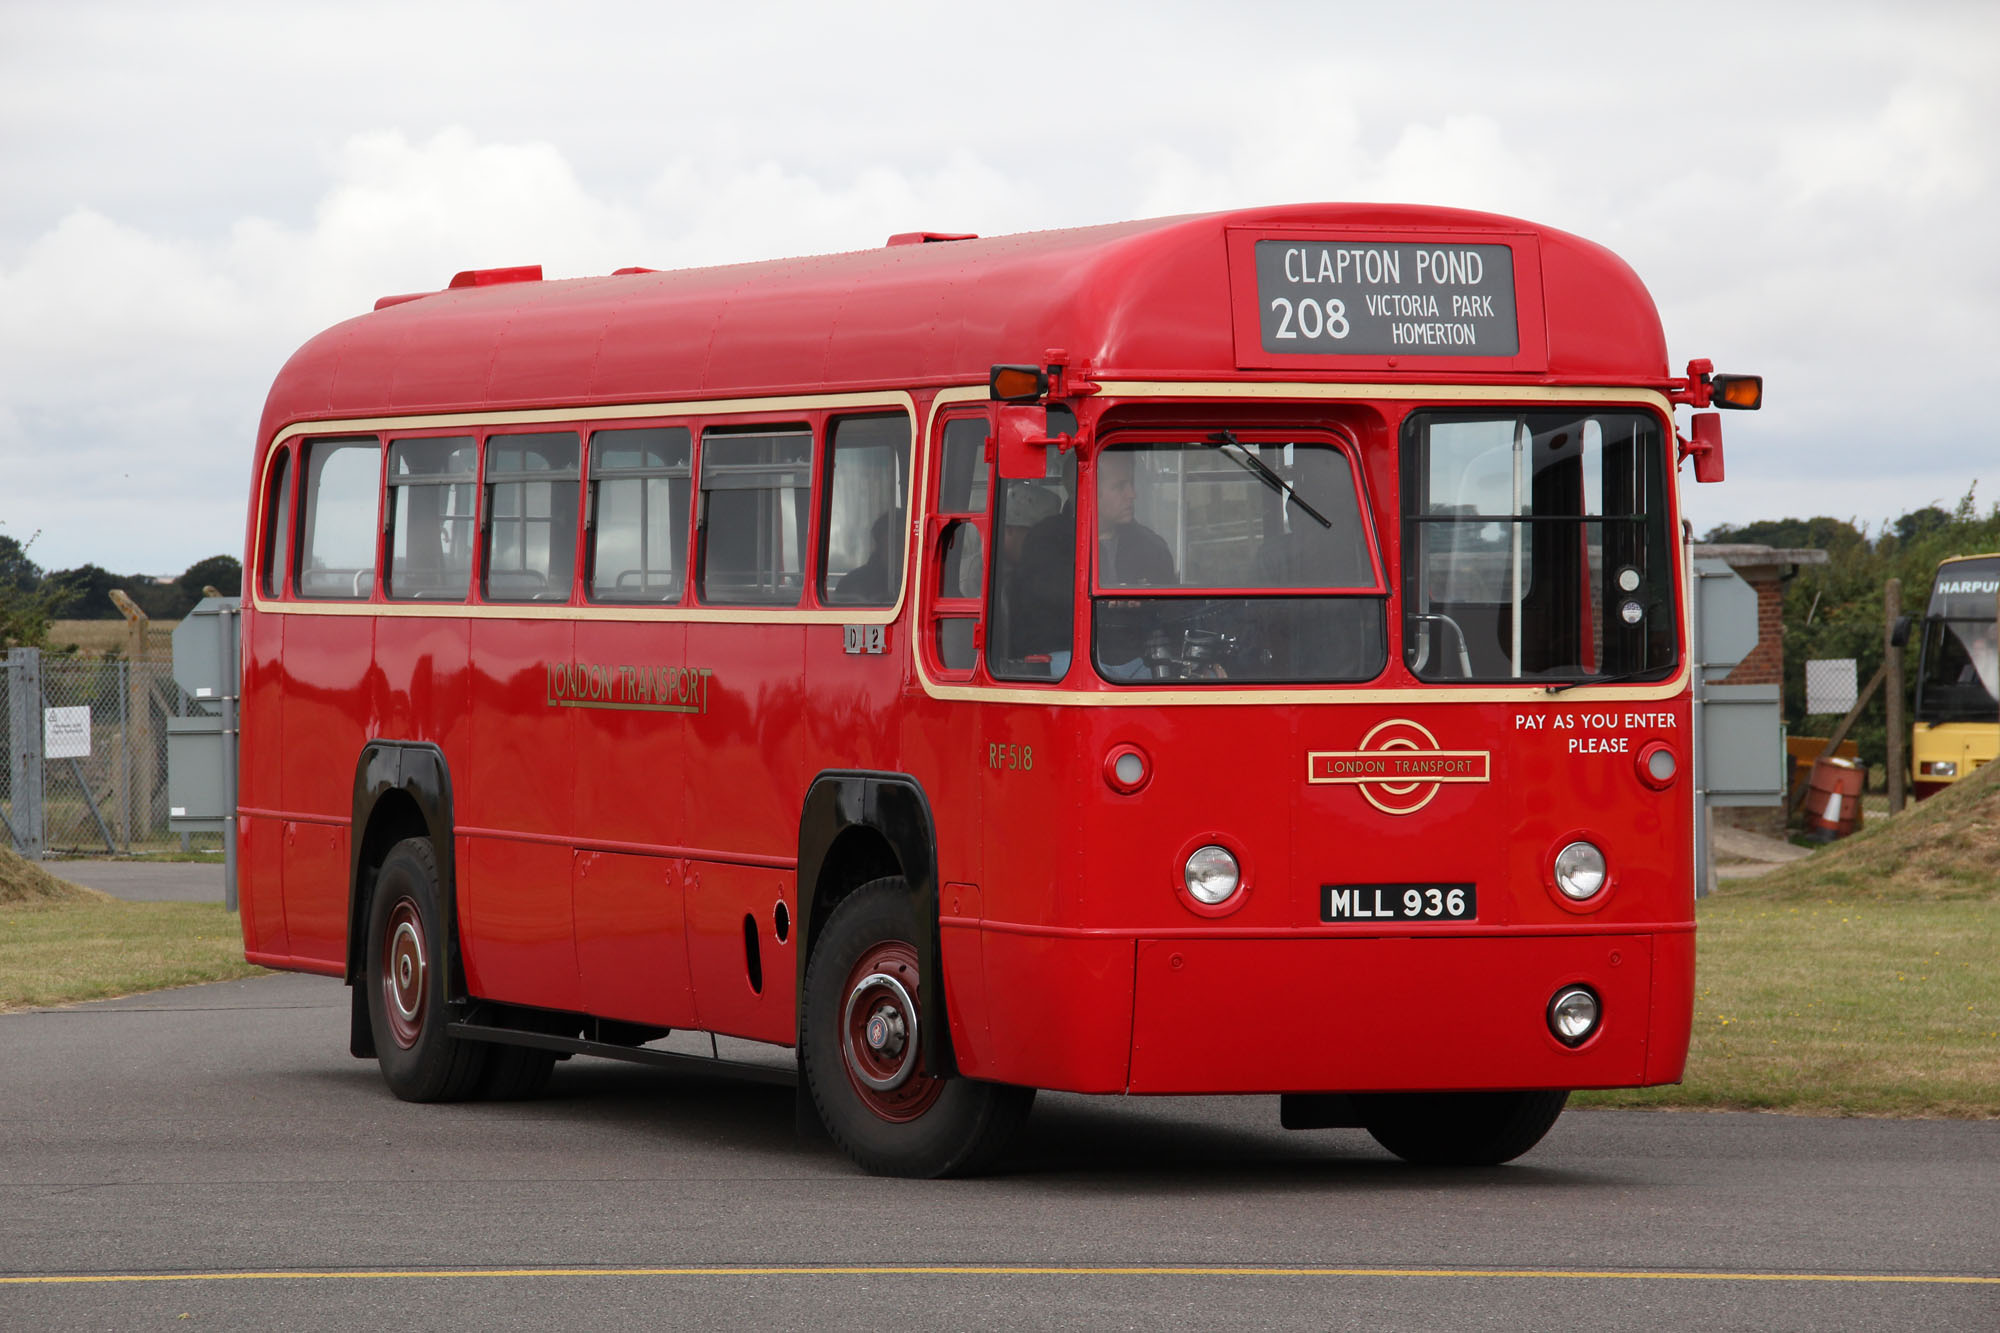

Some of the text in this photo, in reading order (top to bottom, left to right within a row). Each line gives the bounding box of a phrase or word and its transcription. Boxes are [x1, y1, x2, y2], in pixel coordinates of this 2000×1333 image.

[1284, 248, 1483, 285] CLAPTON POND
[1365, 294, 1494, 317] VICTORIA PARK
[1271, 297, 1350, 339] 208
[1392, 323, 1476, 345] HOMERTON
[547, 663, 712, 714] LONDON TRANSPORT
[1515, 713, 1677, 729] PAY AS YOU ENTER
[1568, 738, 1629, 753] PLEASE
[1327, 760, 1473, 773] LONDON TRANSPORT
[1331, 889, 1466, 917] MLL 936
